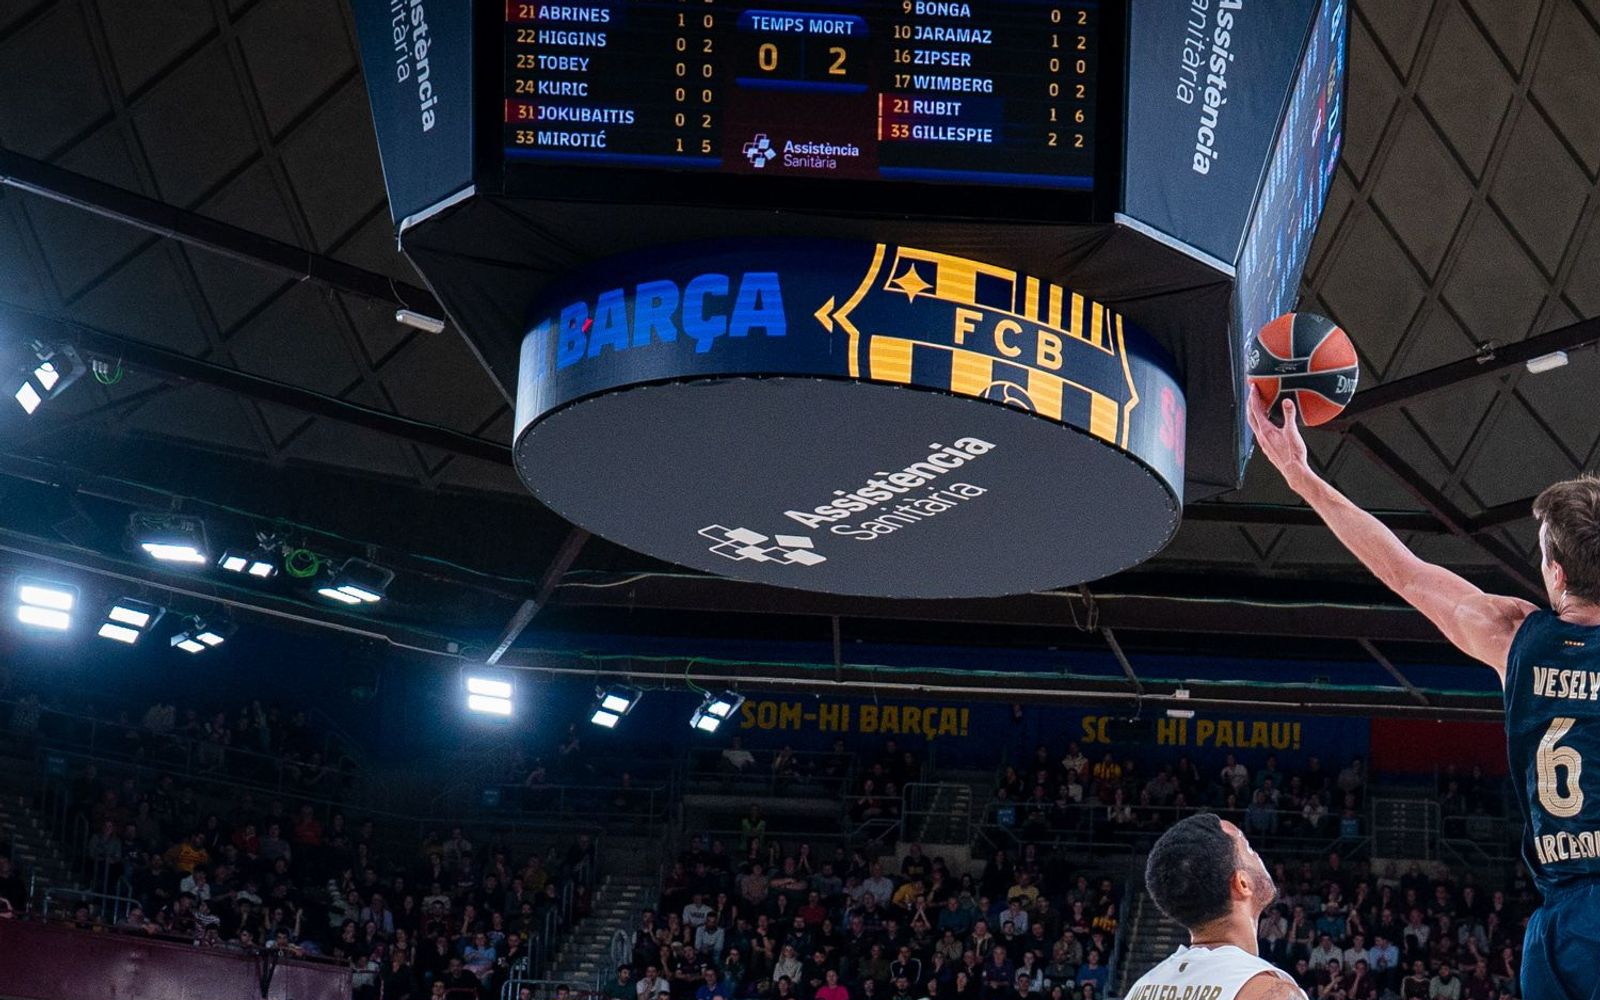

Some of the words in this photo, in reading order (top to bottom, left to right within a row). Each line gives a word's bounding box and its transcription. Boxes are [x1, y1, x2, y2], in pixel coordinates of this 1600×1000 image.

[518, 5, 536, 19] 21
[538, 6, 610, 22] ABRINES
[678, 13, 686, 26] 1
[704, 15, 714, 28] 0
[752, 16, 804, 32] TEMPS
[809, 20, 854, 34] MORT
[916, 2, 970, 18] BONGA
[1052, 10, 1061, 22] 0
[1078, 11, 1086, 24] 2
[517, 29, 536, 44] 22
[538, 30, 607, 47] HIGGINS
[676, 38, 686, 52] 0
[703, 39, 712, 53] 2
[894, 25, 911, 39] 10
[914, 26, 992, 44] JARAMAZ
[1052, 35, 1058, 48] 1
[1077, 36, 1086, 50] 2
[516, 55, 536, 69] 23
[538, 55, 590, 72] TOBEY
[676, 63, 686, 76] 0
[702, 64, 712, 78] 0
[758, 43, 778, 71] 0
[828, 47, 846, 75] 2
[894, 50, 911, 64] 16
[914, 50, 971, 66] ZIPSER
[1050, 58, 1060, 72] 0
[1076, 60, 1086, 74] 0
[515, 80, 536, 94] 24
[538, 80, 588, 97] KURIC
[676, 88, 686, 102] 0
[702, 89, 712, 103] 0
[895, 75, 910, 88] 17
[914, 75, 993, 93] WIMBERG
[1049, 84, 1059, 97] 0
[1076, 85, 1085, 98] 2
[518, 105, 535, 120] 31
[538, 106, 634, 124] JOKUBAITIS
[675, 113, 685, 126] 0
[702, 114, 712, 128] 2
[894, 100, 910, 113] 21
[913, 100, 962, 116] RUBIT
[1050, 108, 1056, 122] 1
[1074, 110, 1084, 123] 6
[516, 130, 535, 144] 33
[538, 130, 606, 148] MIROTIĆ
[676, 138, 684, 152] 1
[702, 140, 712, 153] 5
[784, 140, 860, 156] Assistència
[890, 124, 910, 138] 33
[912, 125, 993, 142] GILLESPIE
[1048, 133, 1057, 146] 2
[1074, 134, 1084, 148] 2
[557, 271, 786, 368] BARÇA
[783, 434, 996, 531] Assistència
[828, 479, 988, 543] Sanitària
[740, 699, 851, 733] SOM-HI
[858, 704, 969, 740] BARÇA!
[1197, 718, 1301, 752] PALAU!
[1536, 717, 1584, 818] 6
